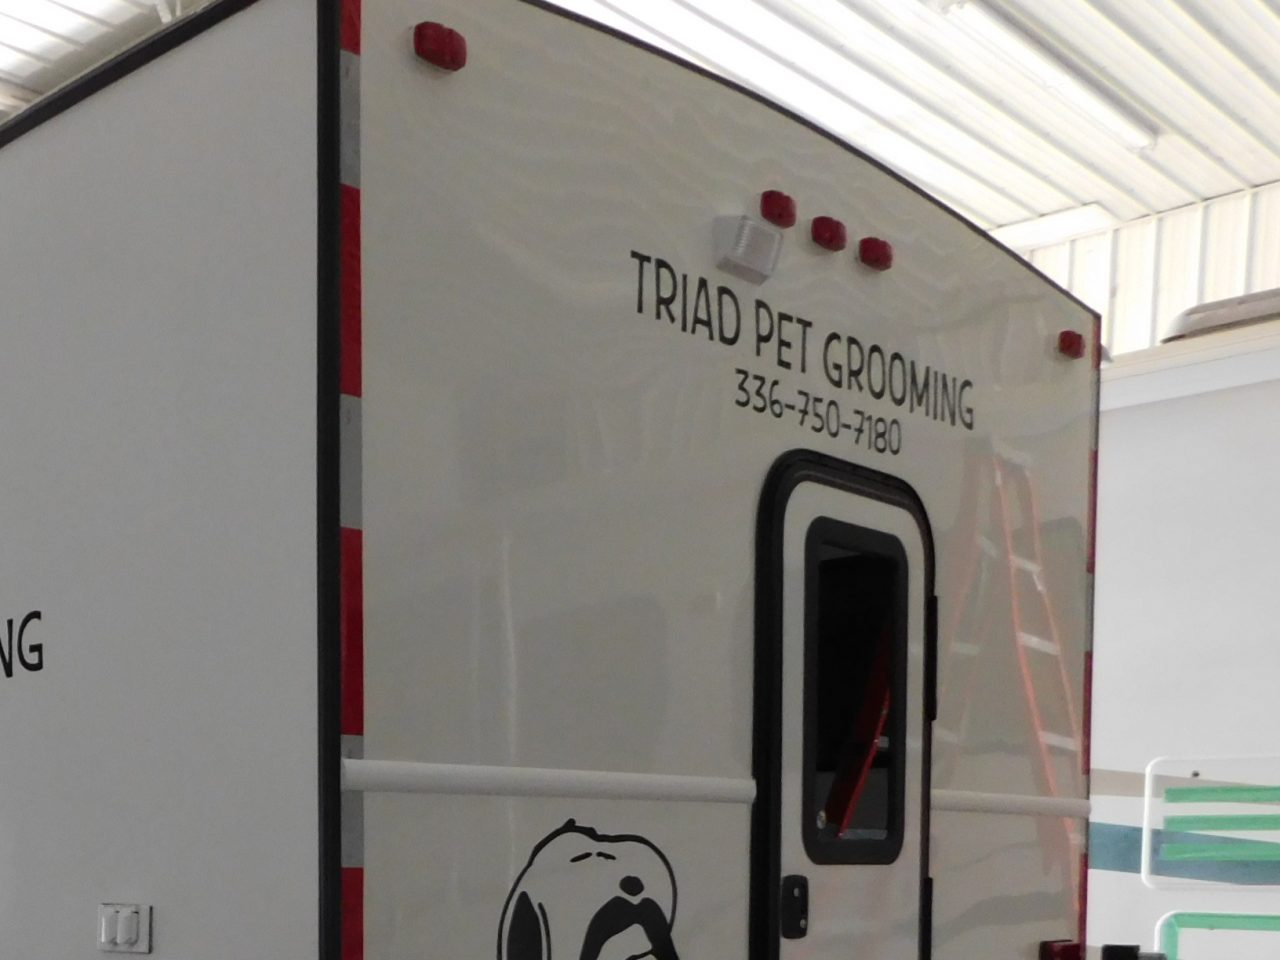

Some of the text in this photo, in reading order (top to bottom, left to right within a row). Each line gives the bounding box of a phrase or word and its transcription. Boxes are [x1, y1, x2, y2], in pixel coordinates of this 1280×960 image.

[630, 249, 974, 431] TRIAD PET GROOMING
[733, 367, 903, 456] 336-750-7180
